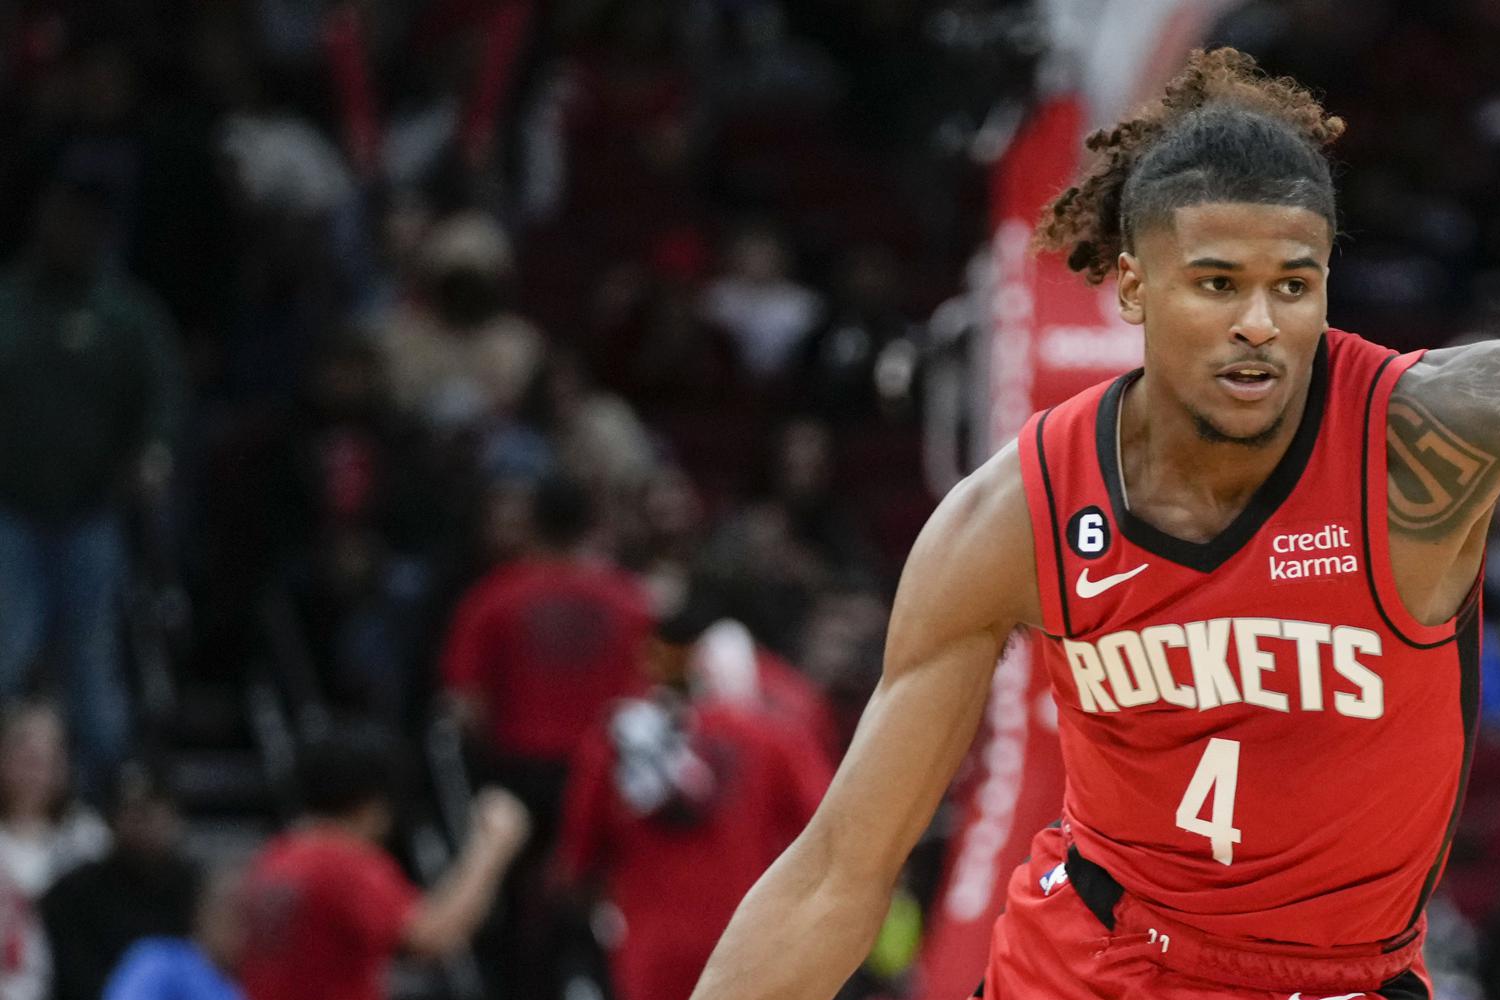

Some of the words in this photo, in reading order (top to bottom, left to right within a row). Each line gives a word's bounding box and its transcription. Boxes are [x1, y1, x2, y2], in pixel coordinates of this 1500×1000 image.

[1078, 513, 1104, 553] 6
[1272, 525, 1351, 553] credit
[1269, 552, 1358, 580] karma
[1063, 617, 1385, 720] ROCKETS
[1175, 737, 1242, 866] 4
